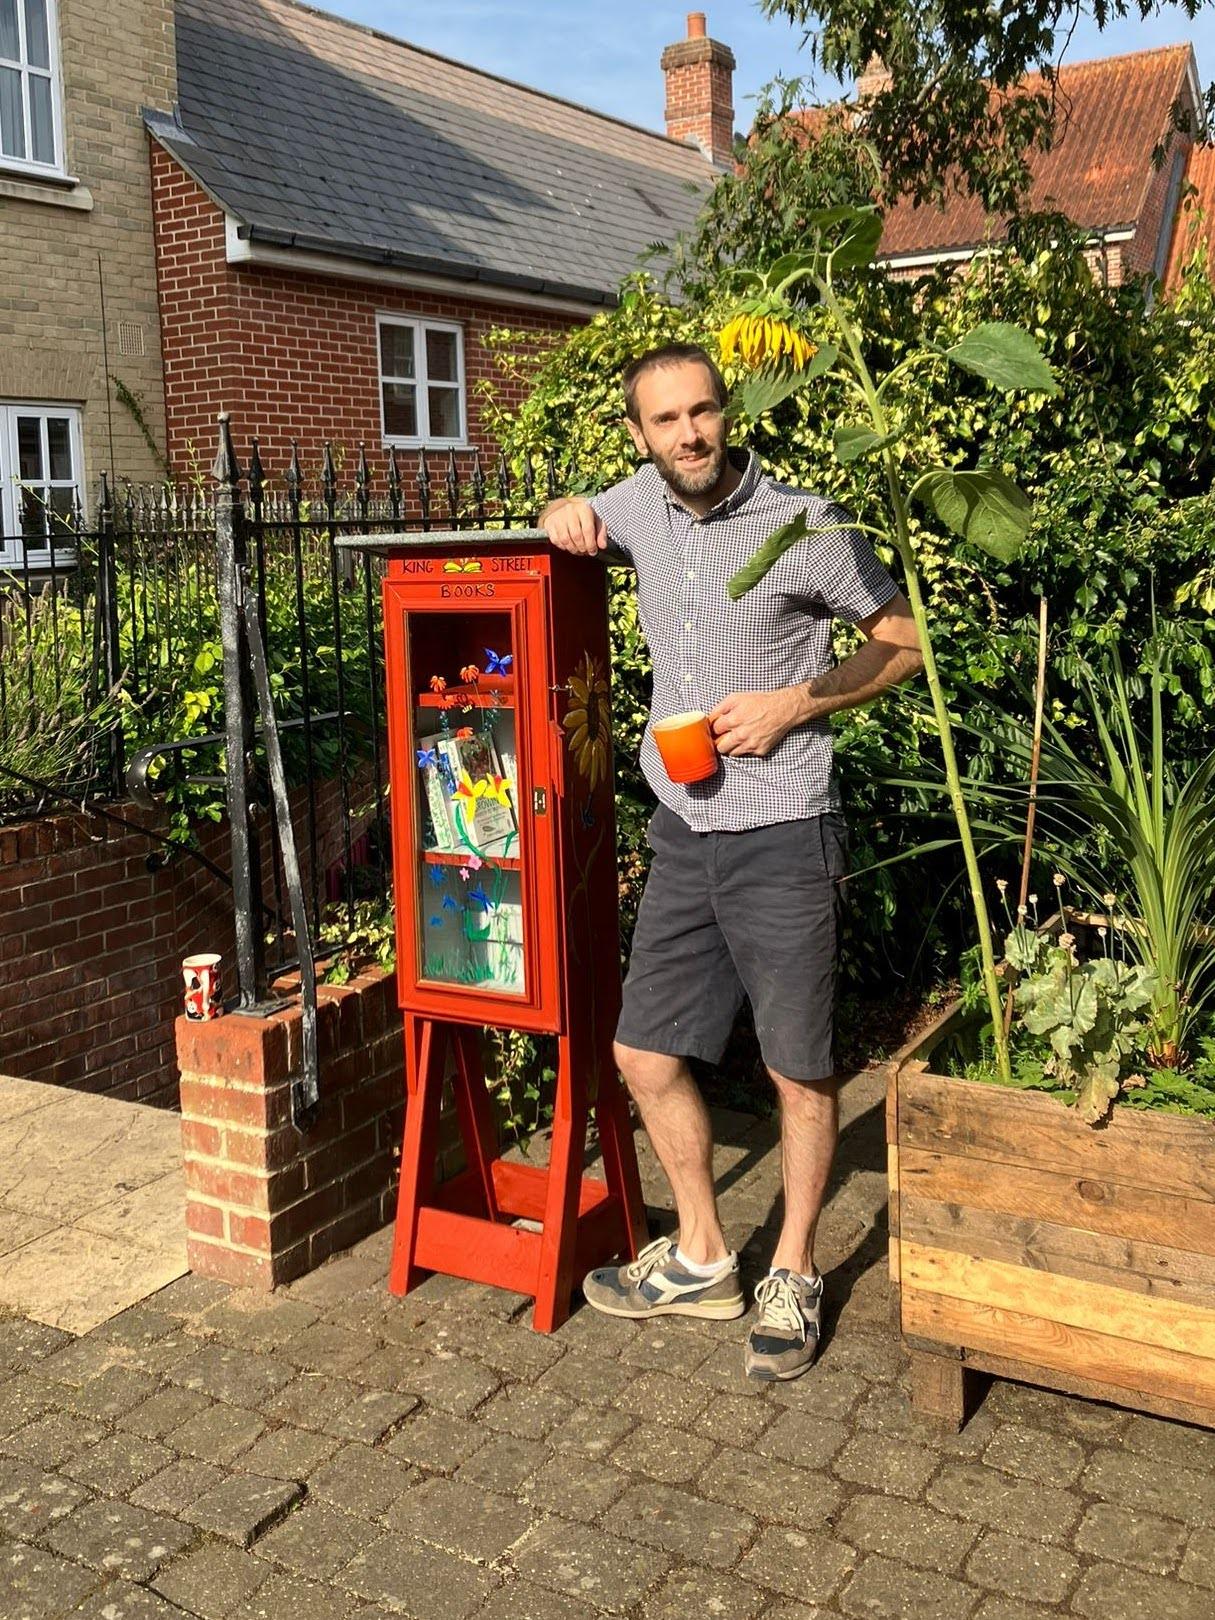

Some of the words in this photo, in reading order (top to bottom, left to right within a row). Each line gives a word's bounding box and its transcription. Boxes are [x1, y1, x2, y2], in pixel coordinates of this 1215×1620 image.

[402, 559, 434, 574] KING
[491, 557, 533, 572] STREET
[440, 583, 495, 598] BOOKS
